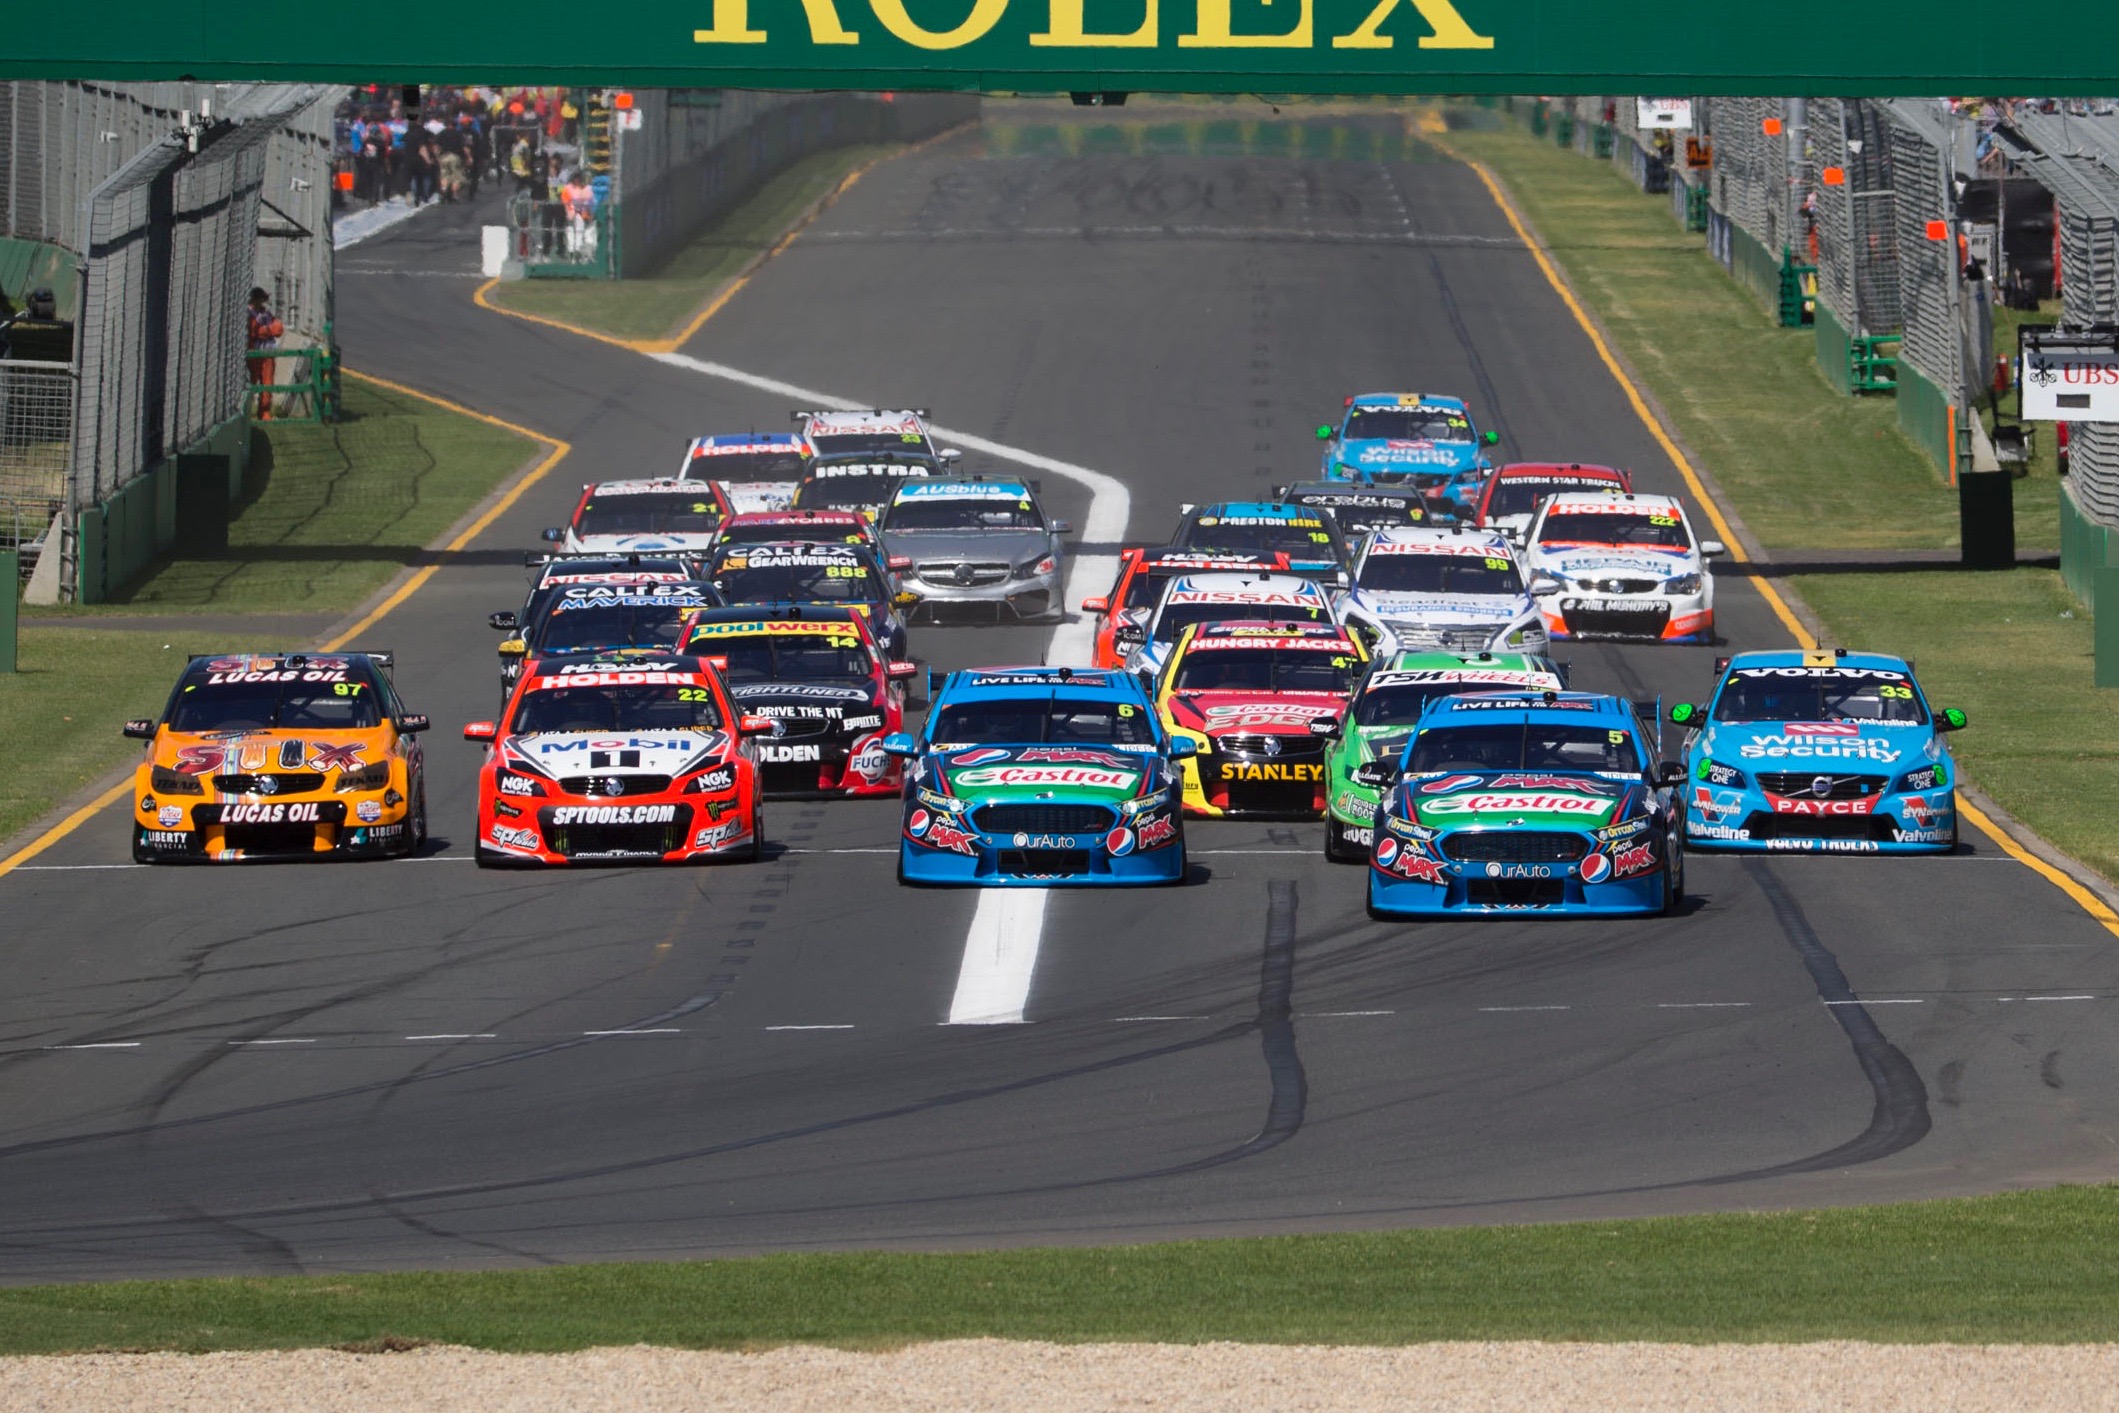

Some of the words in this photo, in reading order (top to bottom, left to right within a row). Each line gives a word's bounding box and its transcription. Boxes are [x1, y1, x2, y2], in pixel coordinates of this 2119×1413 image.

[694, 0, 1494, 50] ROLEX
[2063, 361, 2119, 385] UBS
[814, 424, 922, 434] NISSAN
[915, 484, 1001, 495] AUSblue
[1501, 477, 1550, 485] WESTERN
[1552, 478, 1580, 486] STAR
[1581, 479, 1621, 489] TRUCKS
[1019, 501, 1030, 511] 4
[1559, 504, 1670, 517] HOLDEN
[1288, 519, 1323, 528] HIRE
[1650, 516, 1677, 527] 222
[1308, 532, 1329, 544] 18
[728, 547, 855, 557] CALTEX
[1372, 543, 1509, 558] NISSAN
[748, 555, 858, 568] GEARWRENCH
[1484, 557, 1510, 571] 99
[826, 566, 868, 578] 888
[544, 573, 688, 587] NISSAN
[565, 586, 702, 597] CALTEX
[558, 596, 709, 610] MAVERICK
[1171, 592, 1321, 607] NISSAN
[1306, 607, 1318, 619] 7
[692, 620, 854, 637] poolwerx
[826, 636, 858, 648] 14
[1190, 638, 1281, 650] HUNGRY
[1284, 638, 1354, 650] JACK'S
[208, 671, 298, 685] LUCAS
[303, 670, 349, 682] OIL
[1373, 671, 1447, 685] TSW
[1443, 670, 1548, 686] WHEELS
[1736, 667, 1905, 680] VOLVO
[541, 672, 695, 690] HOLDEN
[972, 677, 1010, 686] LIVE
[1013, 676, 1047, 684] LIFE
[334, 683, 362, 696] 97
[678, 688, 708, 703] 22
[1879, 685, 1913, 699] 33
[1117, 704, 1134, 717] 6
[1453, 701, 1491, 710] LIVE
[1496, 701, 1530, 709] LIFE
[756, 706, 796, 717] DRIVE
[797, 706, 824, 718] THE
[825, 706, 843, 720] NT
[1205, 713, 1311, 732] EDG
[1852, 718, 1919, 727] Valvoline
[1608, 730, 1624, 745] 5
[1751, 735, 1890, 749] Wilson
[541, 738, 691, 754] Mobil
[603, 751, 621, 767] 1
[1740, 745, 1902, 763] Security
[998, 768, 1124, 786] Castrol
[1221, 763, 1323, 781] STANLEY
[1709, 764, 1738, 777] STRATEGY
[501, 776, 535, 793] NGK
[697, 770, 732, 789] NGK
[1711, 773, 1729, 784] ONE
[1913, 779, 1932, 790] ONE
[1467, 794, 1598, 812] Castrol
[1777, 800, 1868, 814] PAYCE
[220, 804, 282, 823] LUCAS
[288, 803, 321, 821] OIL
[553, 804, 676, 826] SPTOOLS.COM
[935, 815, 958, 827] pepsi
[1136, 812, 1156, 829] pepsi
[368, 824, 403, 837] LIBERTY
[1138, 812, 1177, 849] MAX
[1687, 821, 1750, 841] Valvoline
[1892, 828, 1953, 843] Valvoline
[148, 832, 188, 844] LIBERTY
[927, 823, 981, 857] MAX
[1012, 832, 1075, 849] OurAuto
[1765, 839, 1814, 850] VOLVO
[1403, 843, 1427, 855] pepsi
[1612, 840, 1634, 854] pepsi
[1614, 841, 1656, 877] MAX
[1397, 851, 1450, 885] MAX
[1485, 861, 1551, 879] OurAuto
